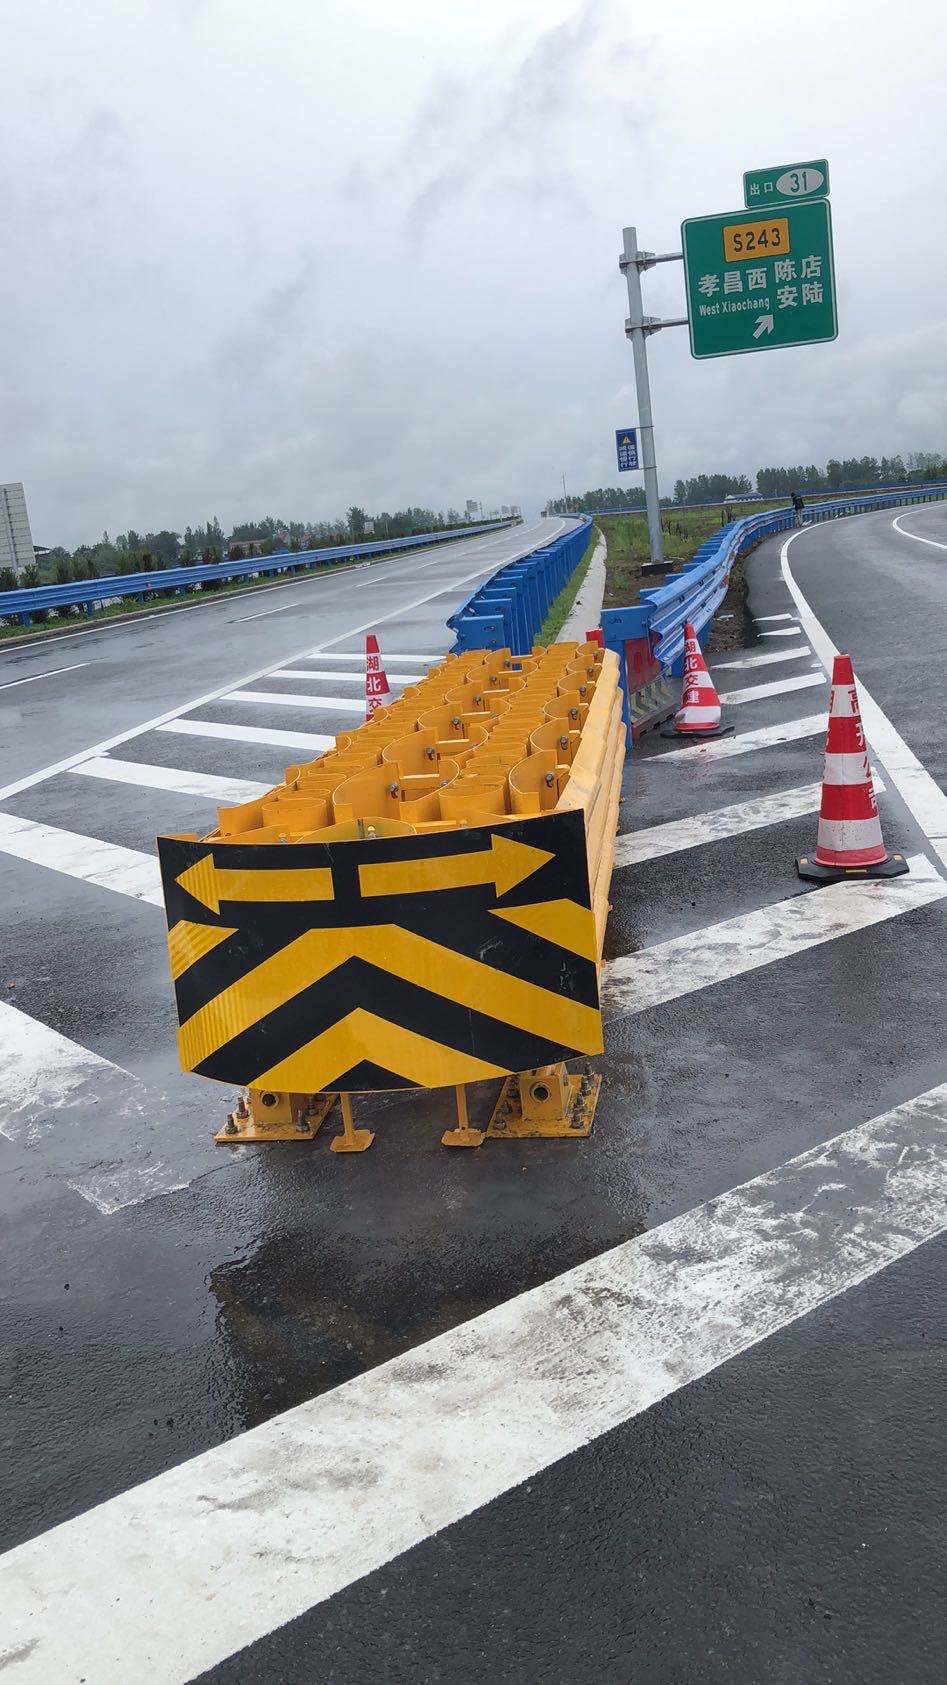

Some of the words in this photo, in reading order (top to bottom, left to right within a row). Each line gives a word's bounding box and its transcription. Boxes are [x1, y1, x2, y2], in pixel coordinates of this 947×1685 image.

[750, 182, 773, 196] 出口
[790, 172, 808, 192] 31
[733, 228, 781, 252] S243
[699, 268, 768, 298] 孝昌西
[774, 254, 822, 283] 陈店
[699, 305, 720, 317] West
[722, 297, 770, 313] Xiaochang
[777, 282, 823, 309] 安陆
